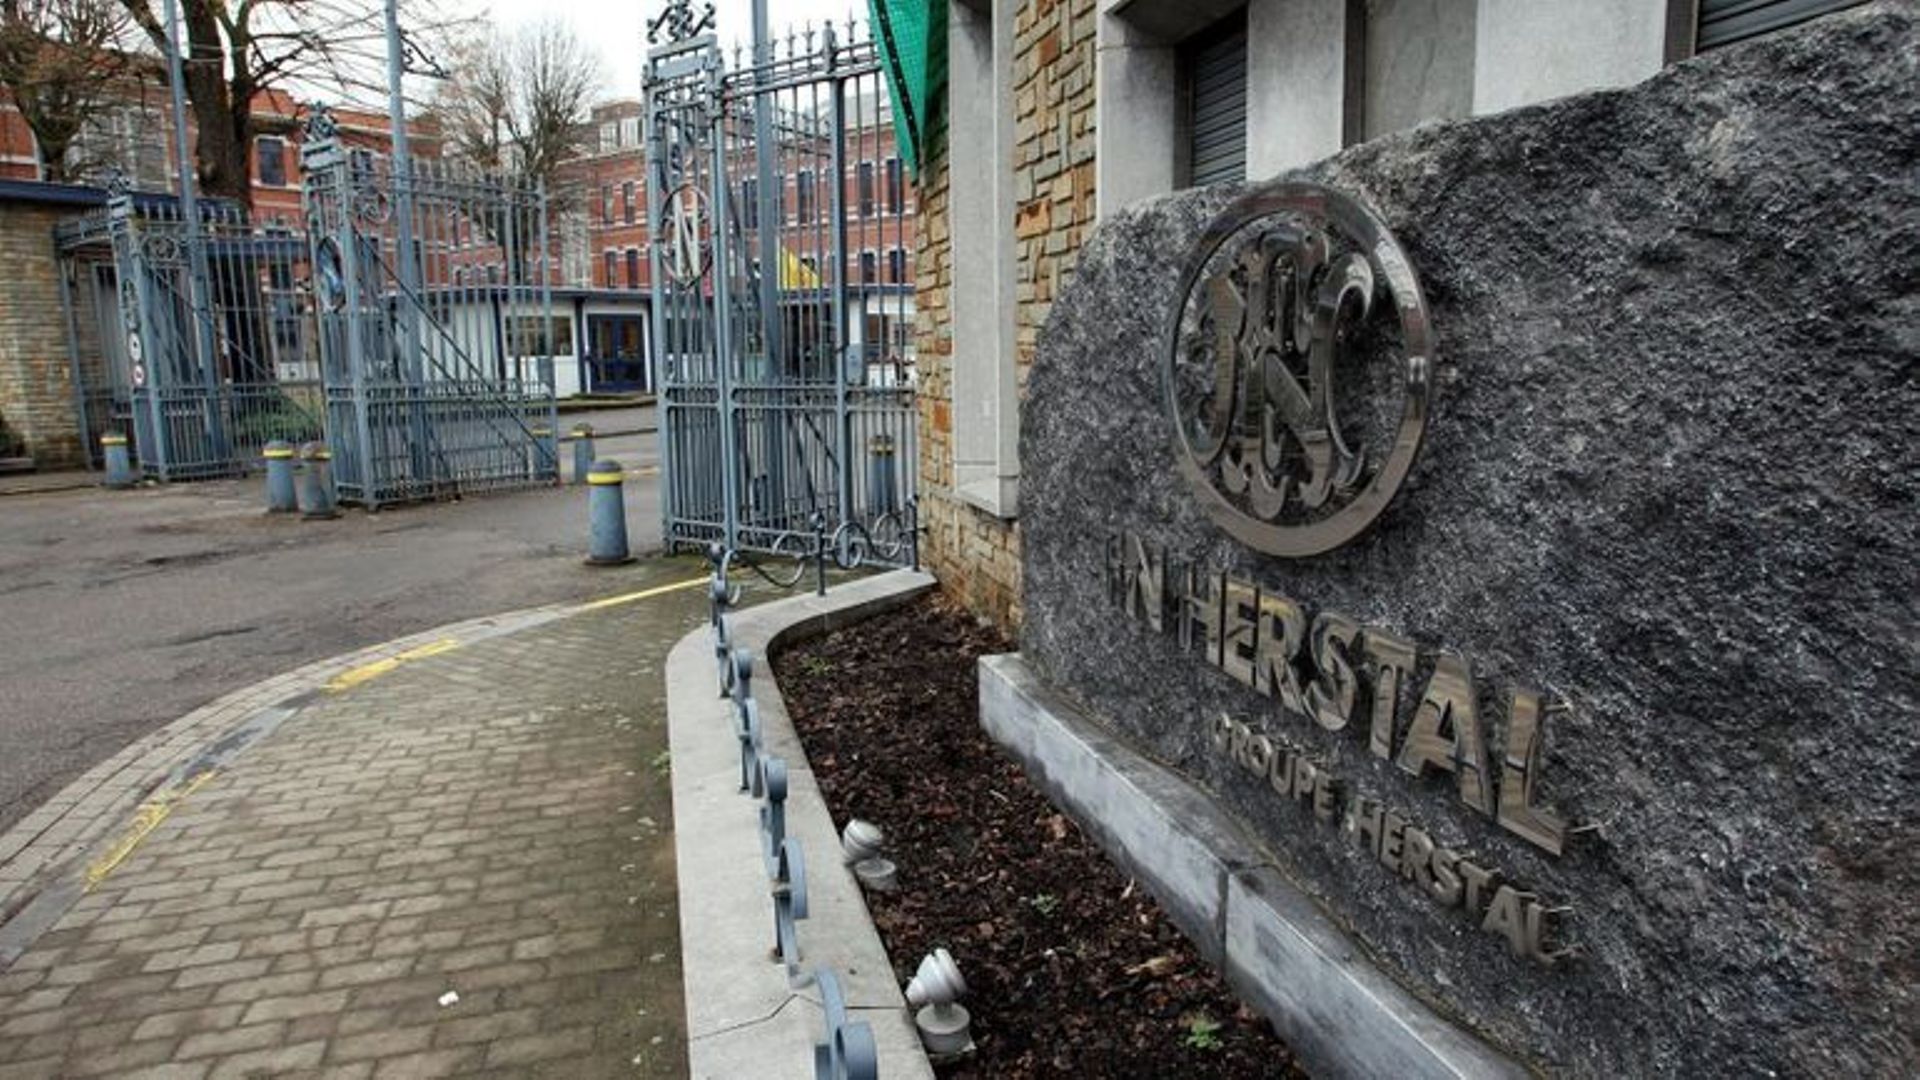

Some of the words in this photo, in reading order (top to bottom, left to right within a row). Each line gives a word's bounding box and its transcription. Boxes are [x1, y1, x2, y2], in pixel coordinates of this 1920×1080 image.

[1178, 562, 1567, 857] HERSTAL
[1211, 712, 1334, 820] GROUPE
[1348, 798, 1556, 967] HERSTAL
